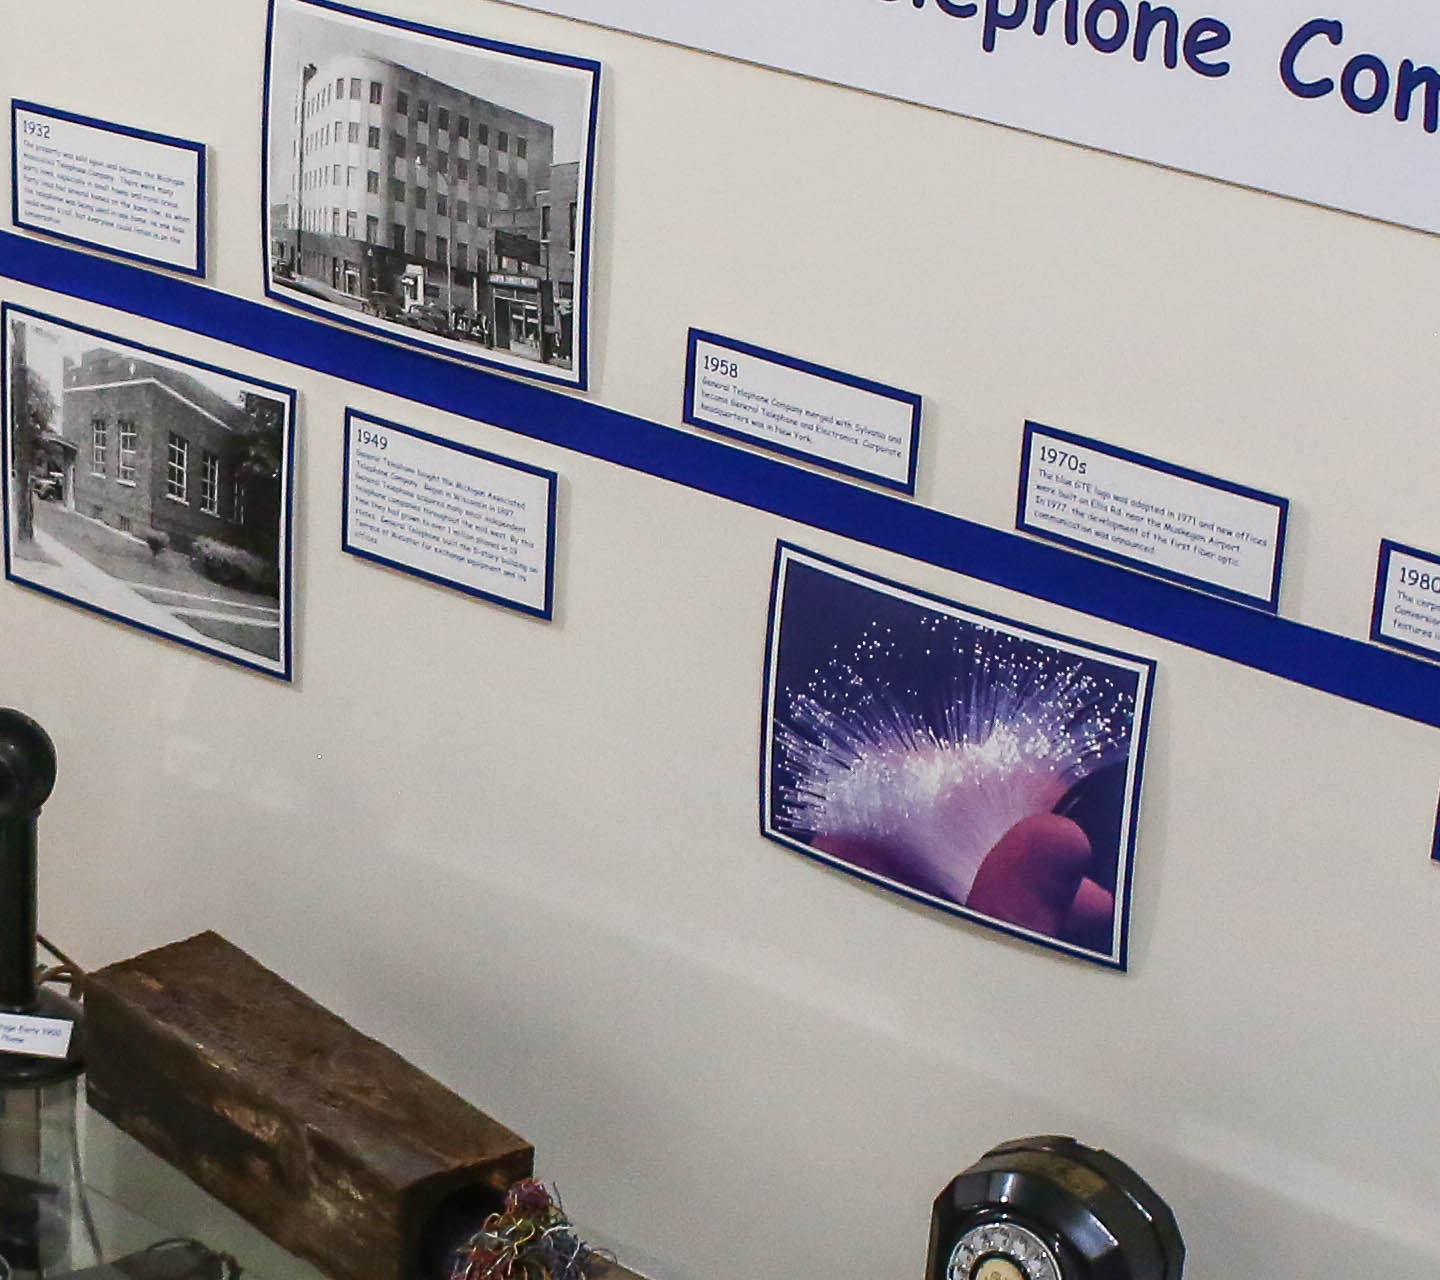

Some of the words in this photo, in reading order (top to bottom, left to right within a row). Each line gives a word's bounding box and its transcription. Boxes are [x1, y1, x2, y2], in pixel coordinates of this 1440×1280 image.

[23, 119, 49, 139] 1932
[703, 353, 738, 379] 1958
[357, 428, 387, 451] 1949
[1039, 445, 1087, 475] 1970s
